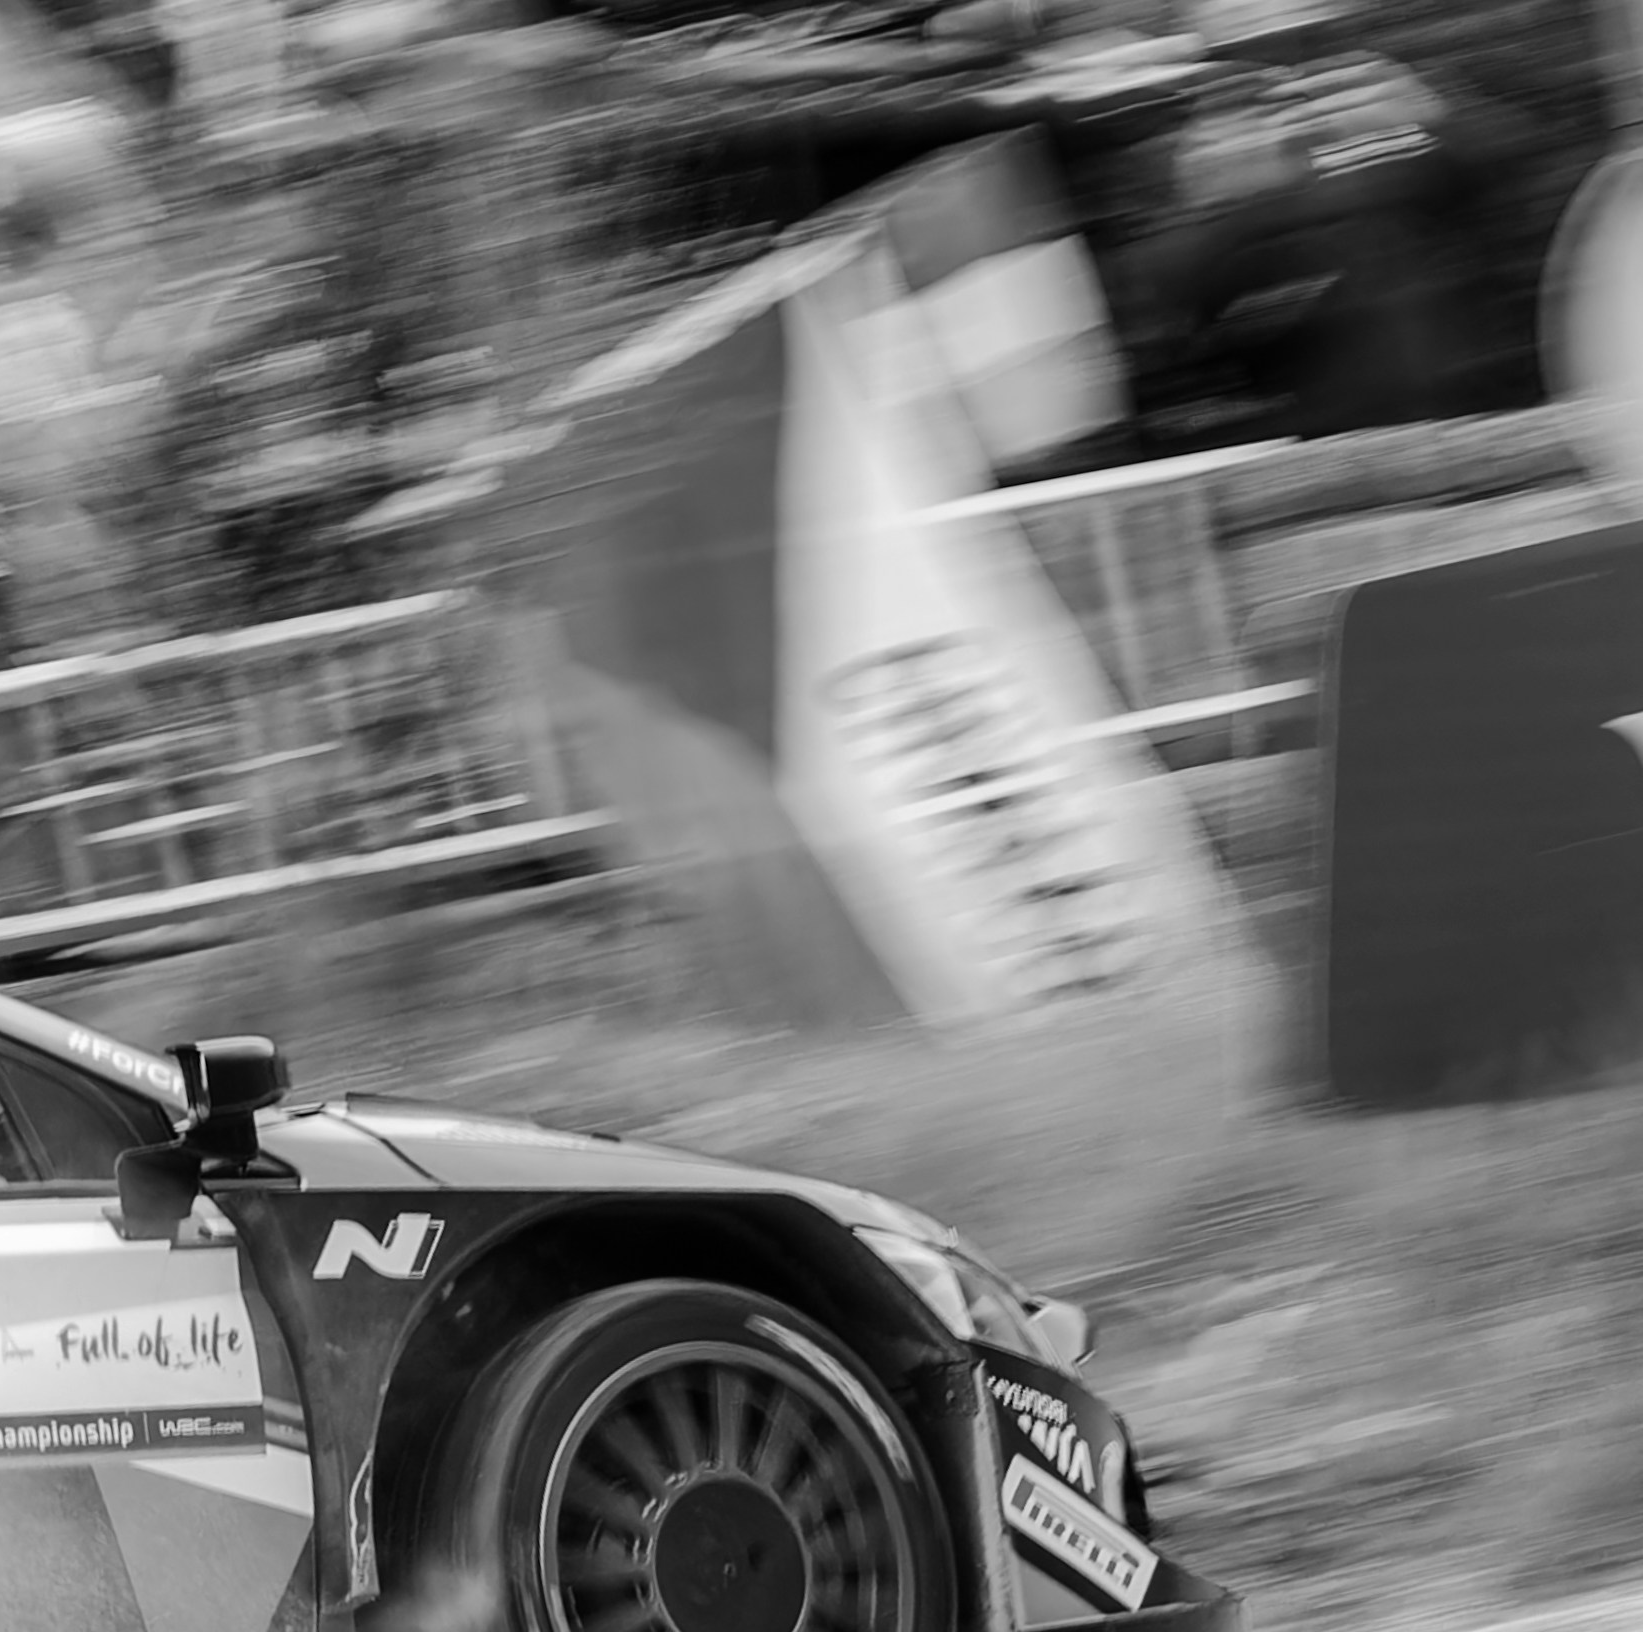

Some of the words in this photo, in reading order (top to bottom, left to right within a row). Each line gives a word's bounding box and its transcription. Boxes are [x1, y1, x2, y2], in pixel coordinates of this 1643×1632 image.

[313, 1213, 445, 1279] N
[57, 1315, 127, 1366] Full
[137, 1316, 175, 1368] of
[191, 1313, 243, 1368] life
